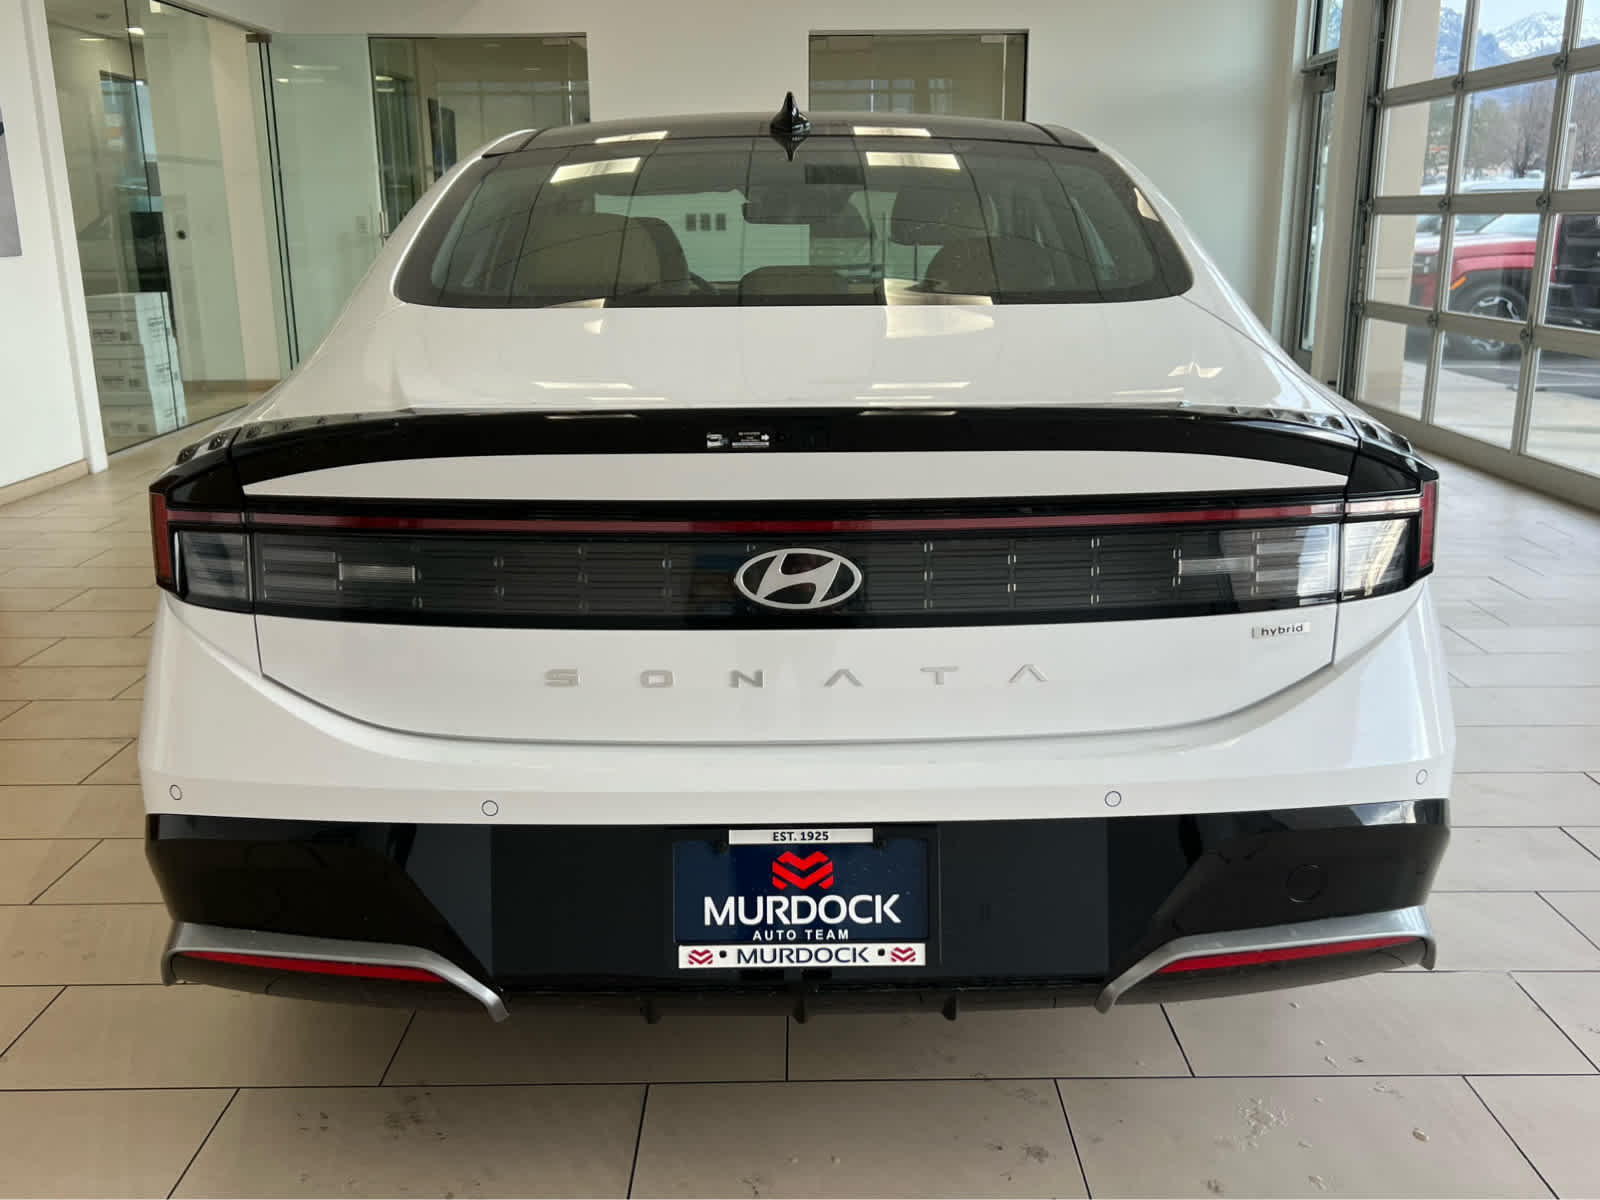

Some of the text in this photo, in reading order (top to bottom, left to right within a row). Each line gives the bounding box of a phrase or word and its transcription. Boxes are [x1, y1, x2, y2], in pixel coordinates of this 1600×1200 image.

[1261, 623, 1303, 637] hybrid
[543, 663, 1049, 689] SONATA
[772, 831, 830, 842] EST. 1925
[704, 894, 902, 926] MURDOCK
[752, 928, 849, 941] AUTO TEAM
[736, 946, 870, 965] MURDOCK
